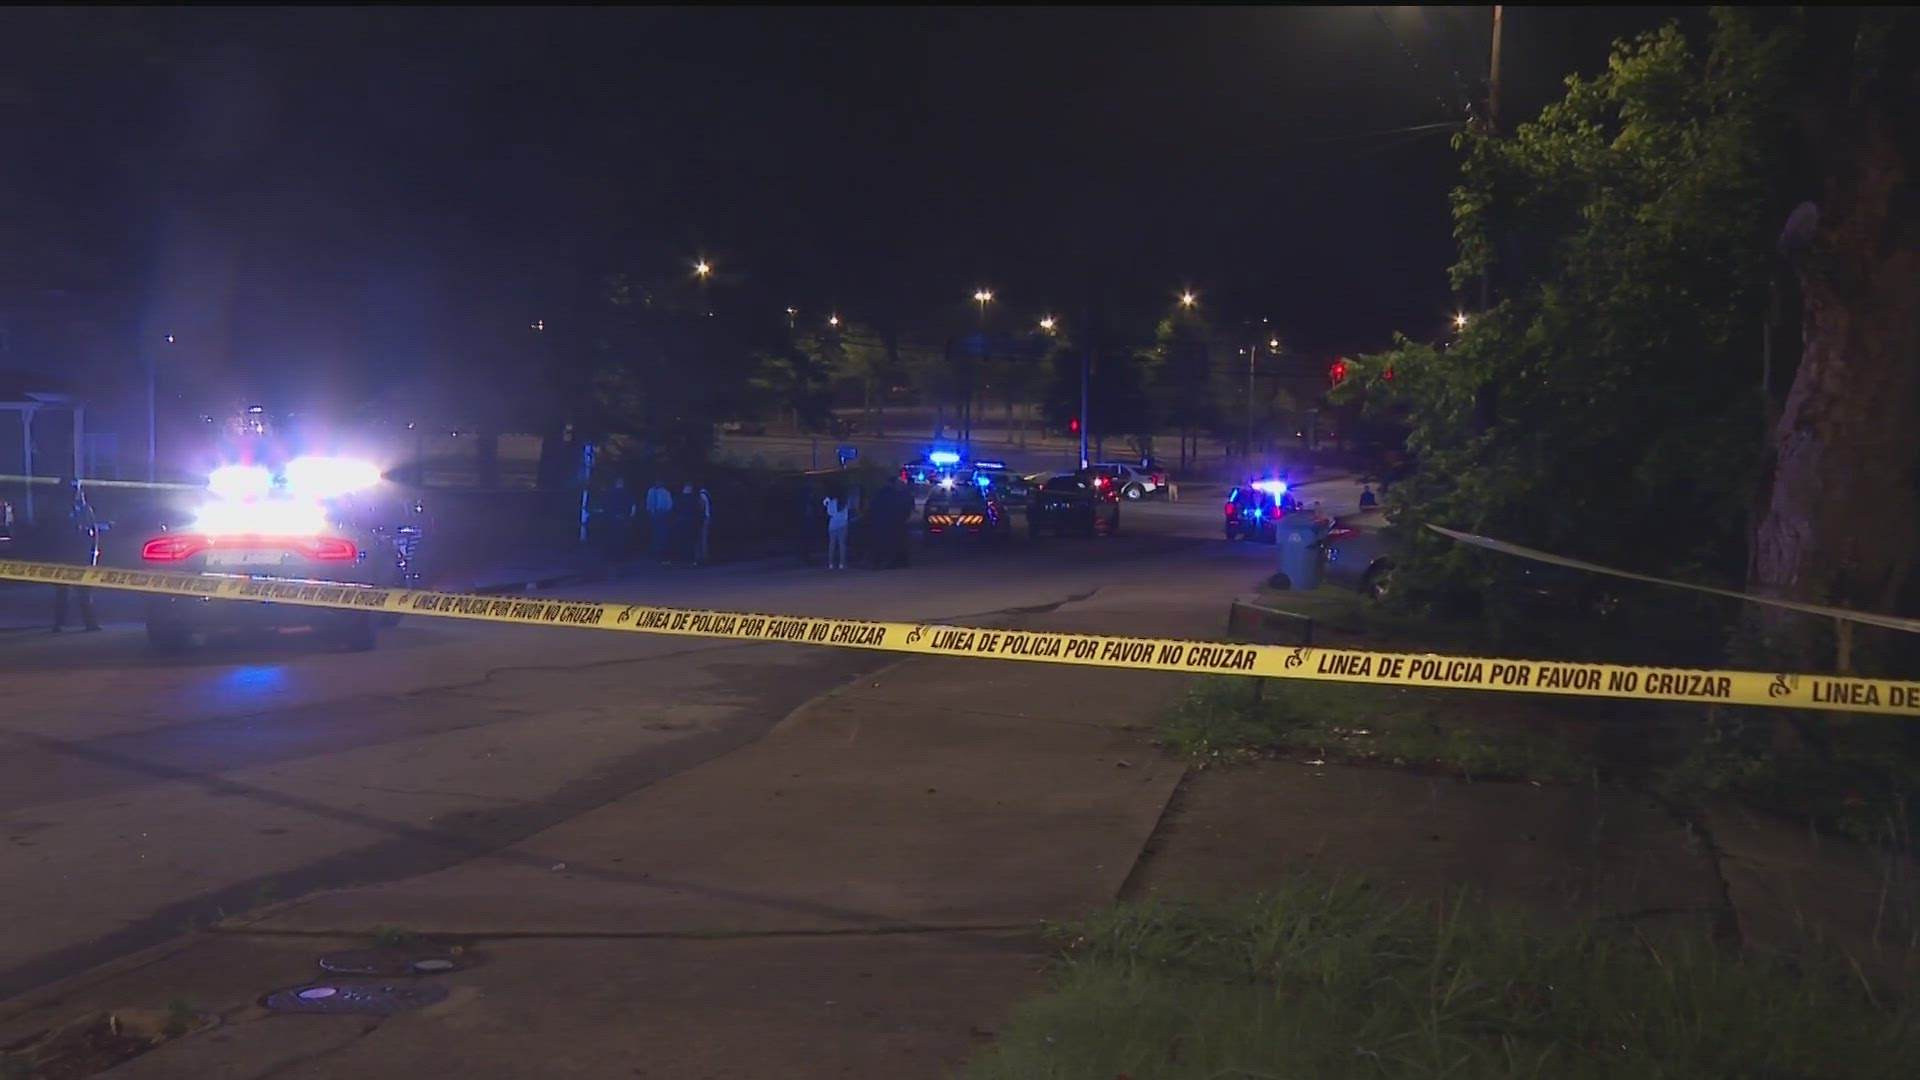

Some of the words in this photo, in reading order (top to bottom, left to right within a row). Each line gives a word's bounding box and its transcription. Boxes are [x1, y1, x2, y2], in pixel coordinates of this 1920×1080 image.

[636, 611, 668, 630] LINEA
[671, 613, 690, 631] DE
[688, 614, 736, 635] POLICIA
[739, 618, 765, 637] POR
[764, 619, 808, 640] FAVOR
[808, 623, 828, 642] NO
[830, 624, 886, 646] CRUZAR
[930, 630, 975, 651] LINEA
[977, 633, 1001, 652] DE
[999, 634, 1061, 657] POLICIA
[1064, 638, 1098, 659] POR
[1100, 640, 1153, 663] FAVOR
[1157, 644, 1183, 665] NO
[1186, 647, 1258, 670] CRUZAR
[1317, 653, 1371, 677] LINEA
[1377, 656, 1405, 678] DE
[1408, 659, 1483, 684] POLICIA
[1489, 664, 1531, 686] POR
[1536, 667, 1603, 690] FAVOR
[1608, 671, 1638, 693] NO
[1645, 673, 1732, 698] CRUZAR
[1812, 681, 1881, 706] LINEA
[1888, 685, 1920, 709] DE
